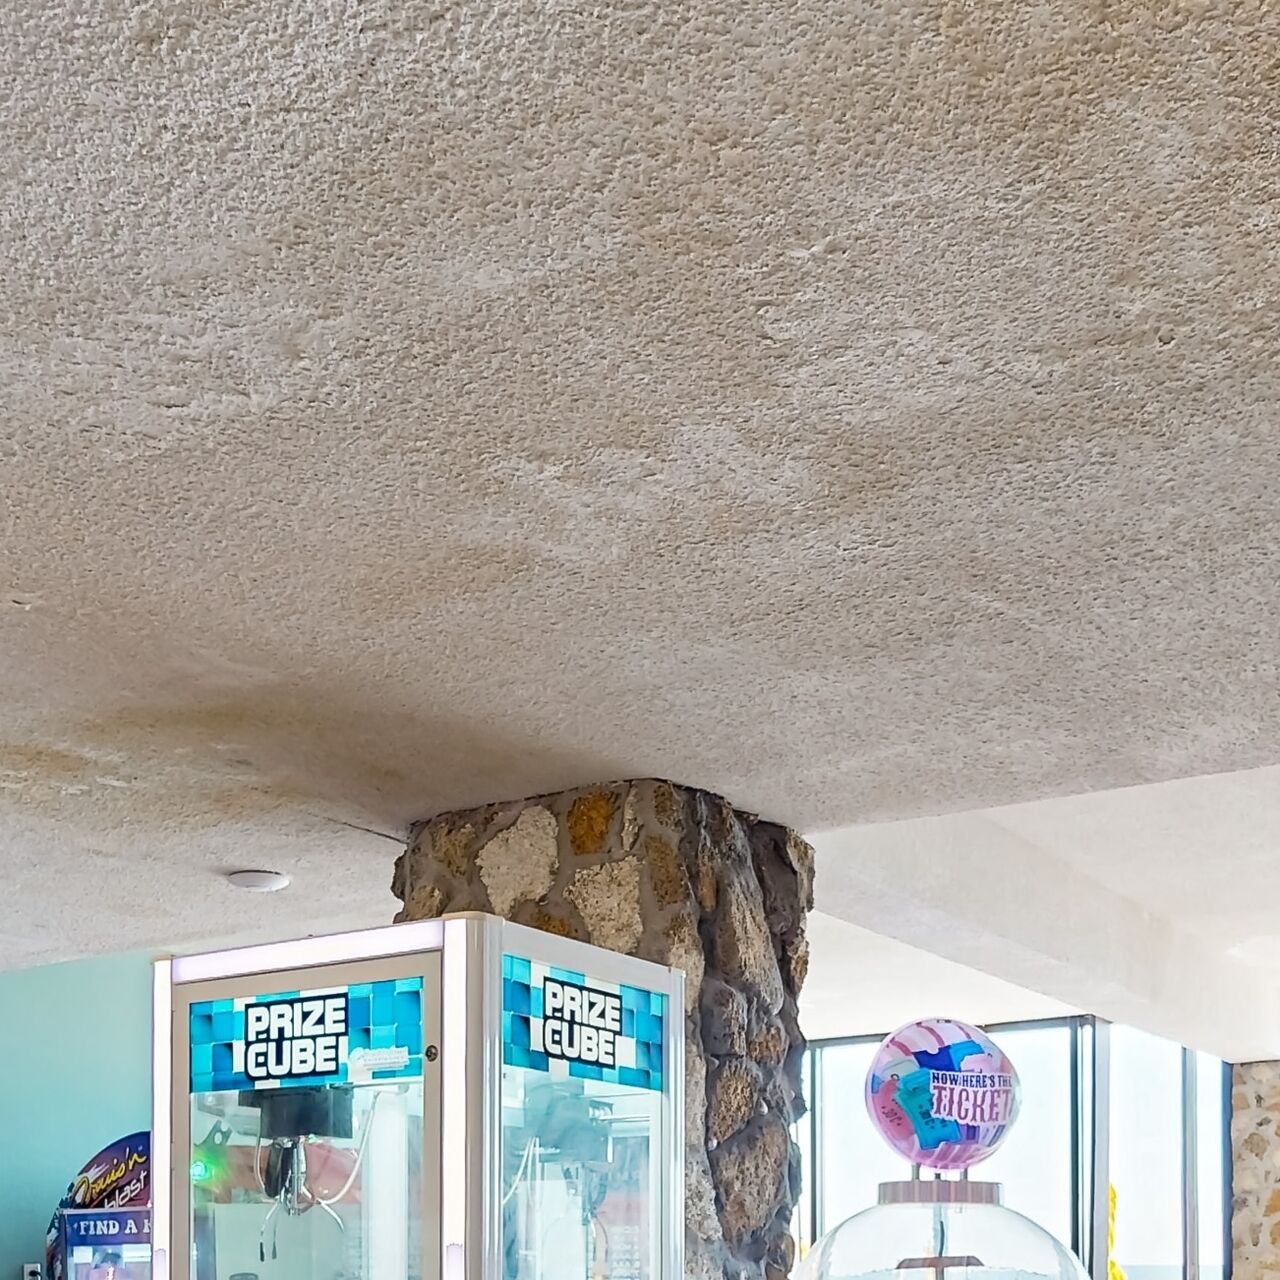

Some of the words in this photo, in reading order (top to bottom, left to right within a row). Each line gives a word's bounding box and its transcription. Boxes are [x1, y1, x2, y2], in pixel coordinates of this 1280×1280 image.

[247, 997, 346, 1042] PRIZE
[542, 980, 621, 1032] PRIZE
[247, 1035, 337, 1077] CUBE
[544, 1018, 614, 1066] CUBE
[933, 1085, 1013, 1123] TICKET
[79, 1220, 120, 1236] FIND
[124, 1219, 138, 1235] A
